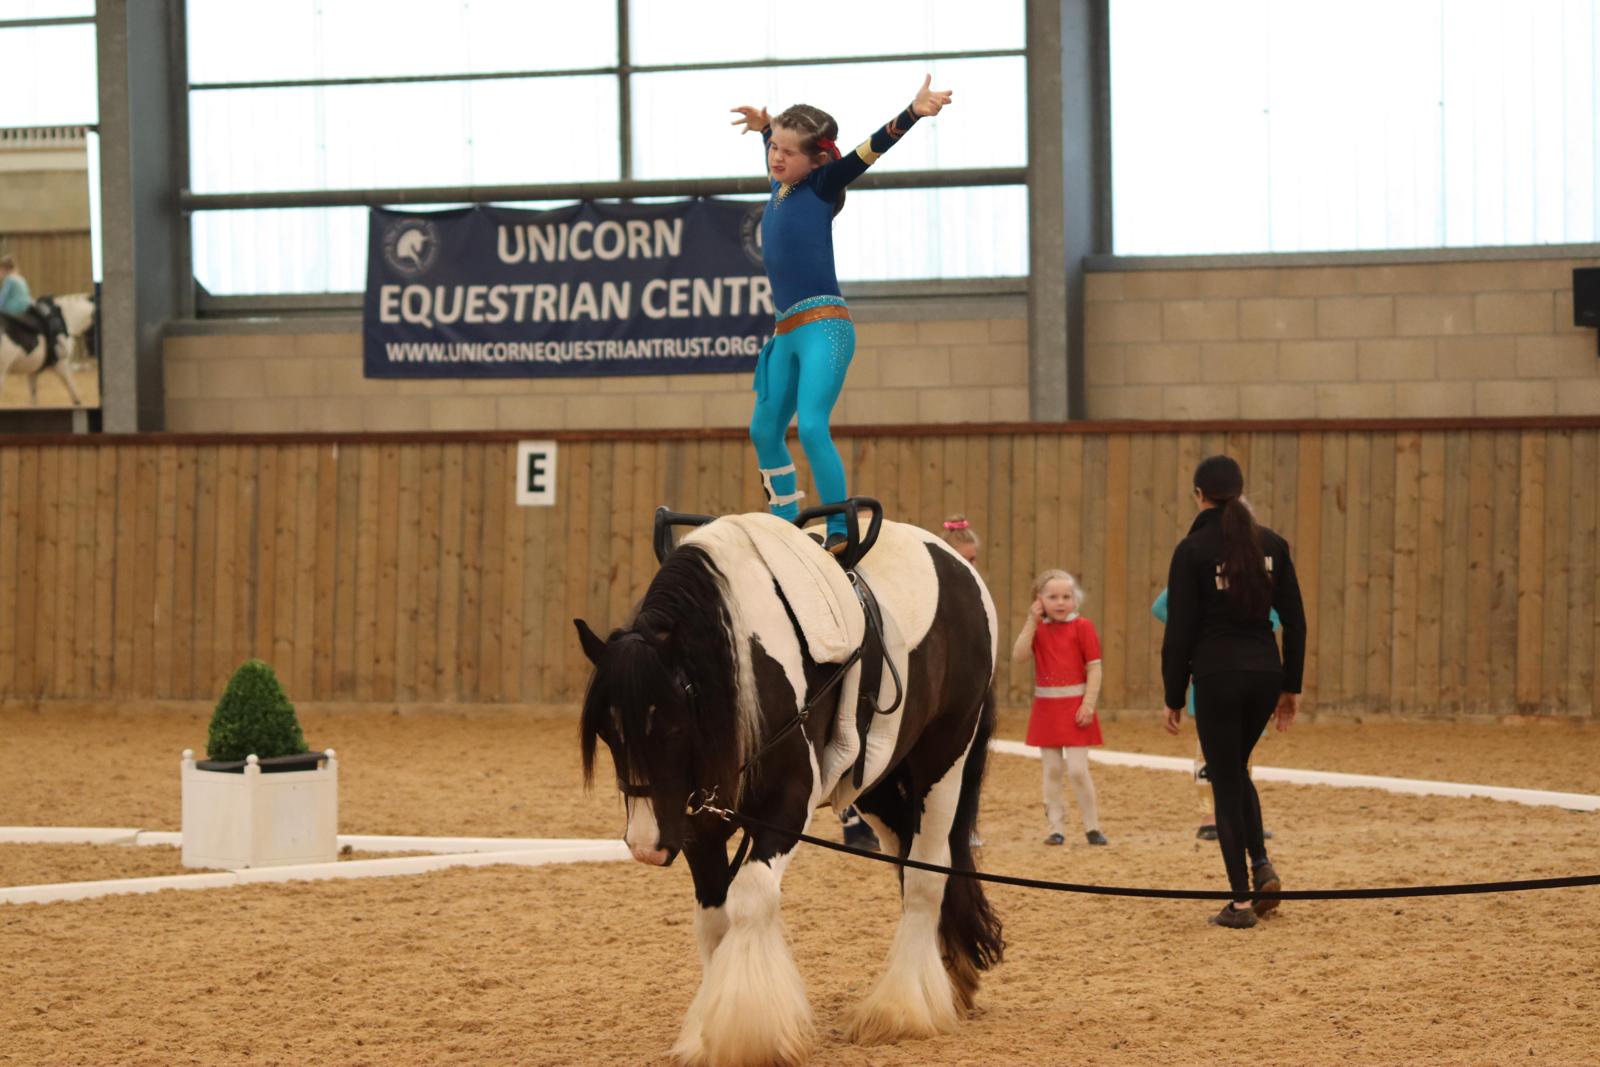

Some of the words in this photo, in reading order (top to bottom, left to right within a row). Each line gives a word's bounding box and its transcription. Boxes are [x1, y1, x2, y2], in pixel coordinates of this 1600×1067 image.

[498, 217, 683, 264] UNICORN
[379, 280, 632, 328] EQUESTRIAN
[641, 275, 774, 318] CENTR
[386, 335, 769, 364] WWW.UNICORNEQUESTRIANTRUST.ORG.
[527, 453, 546, 492] E
